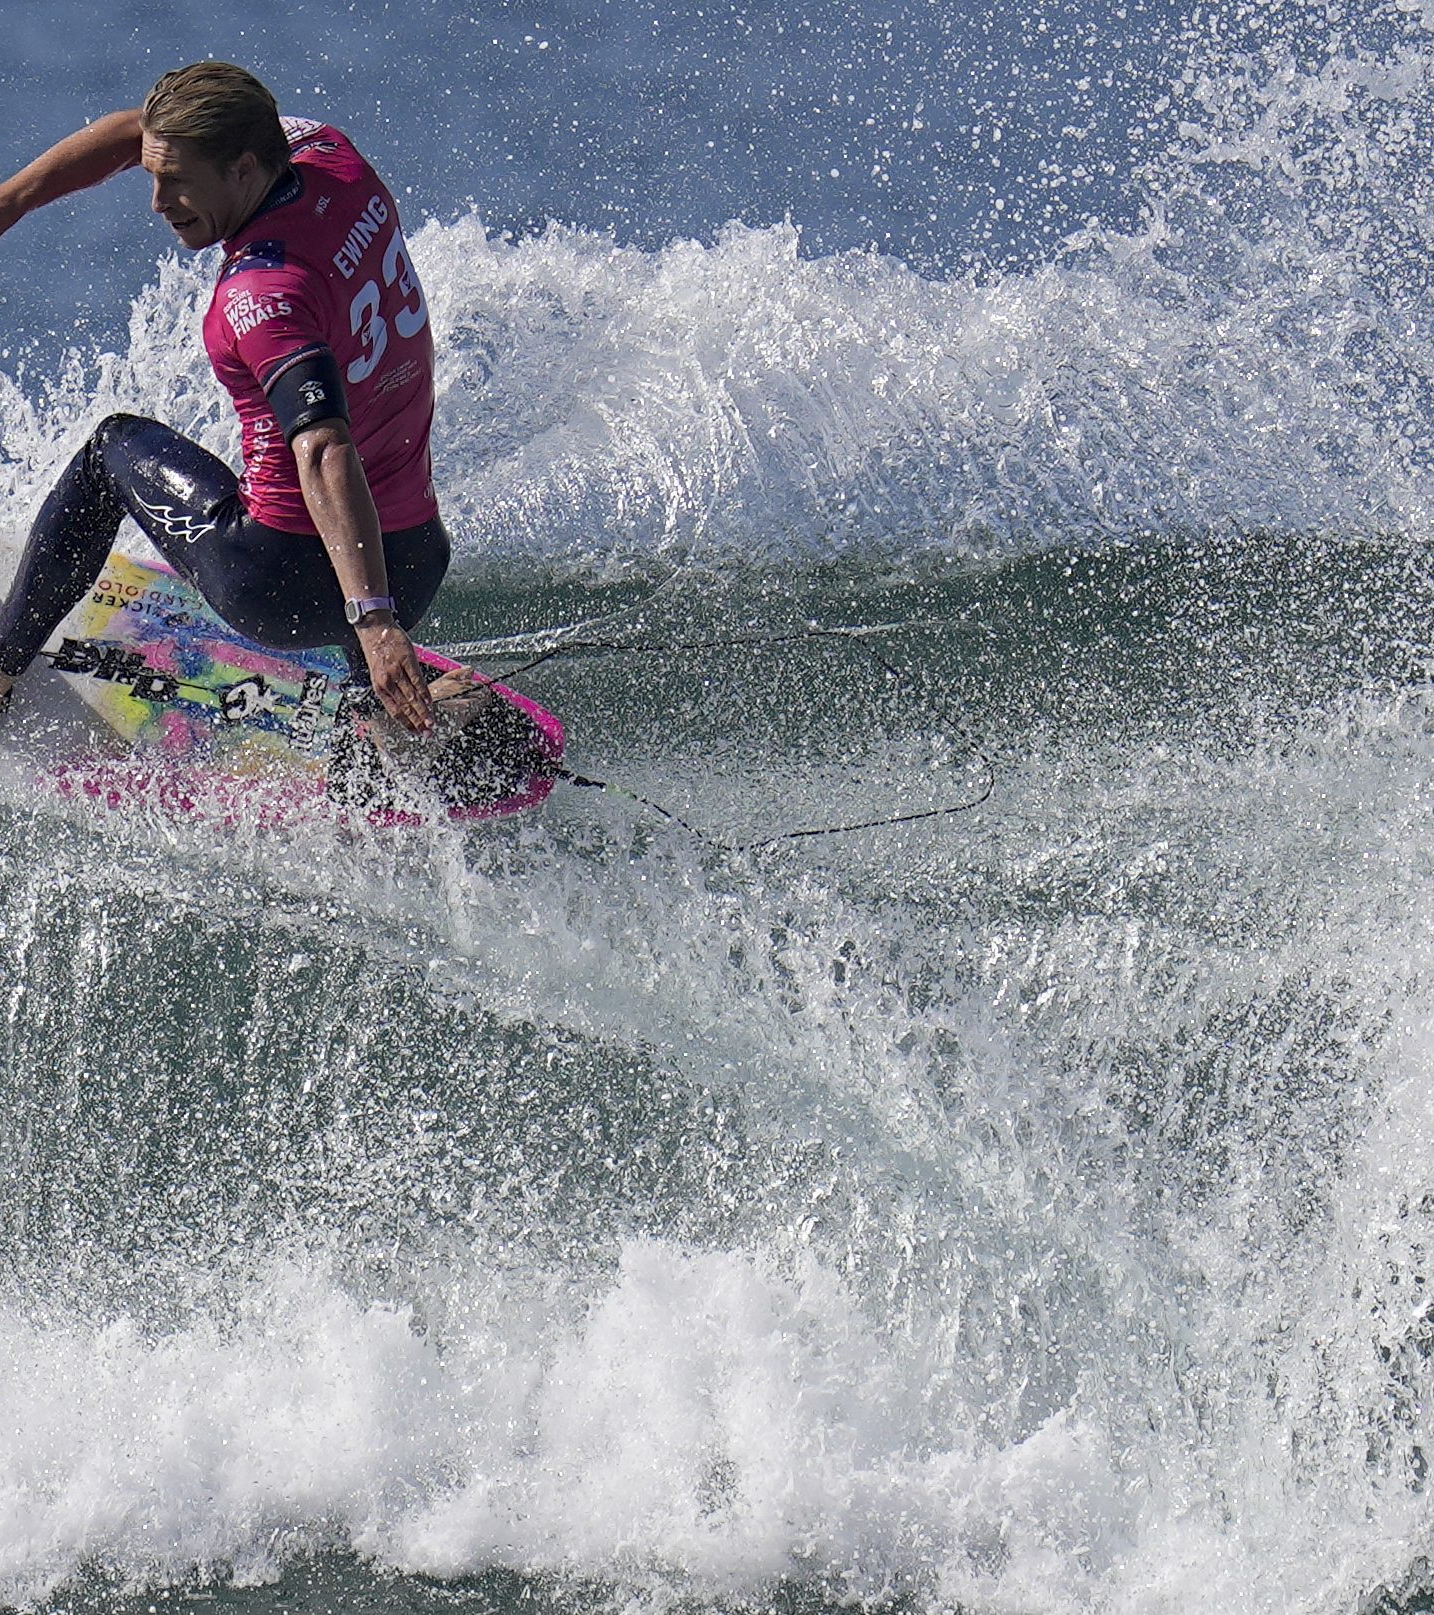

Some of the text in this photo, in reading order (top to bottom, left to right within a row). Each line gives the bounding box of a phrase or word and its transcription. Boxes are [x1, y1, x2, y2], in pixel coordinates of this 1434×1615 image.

[333, 195, 388, 279] EWING
[226, 296, 262, 327] WSL
[233, 302, 292, 340] FINALS
[346, 226, 428, 384] 33
